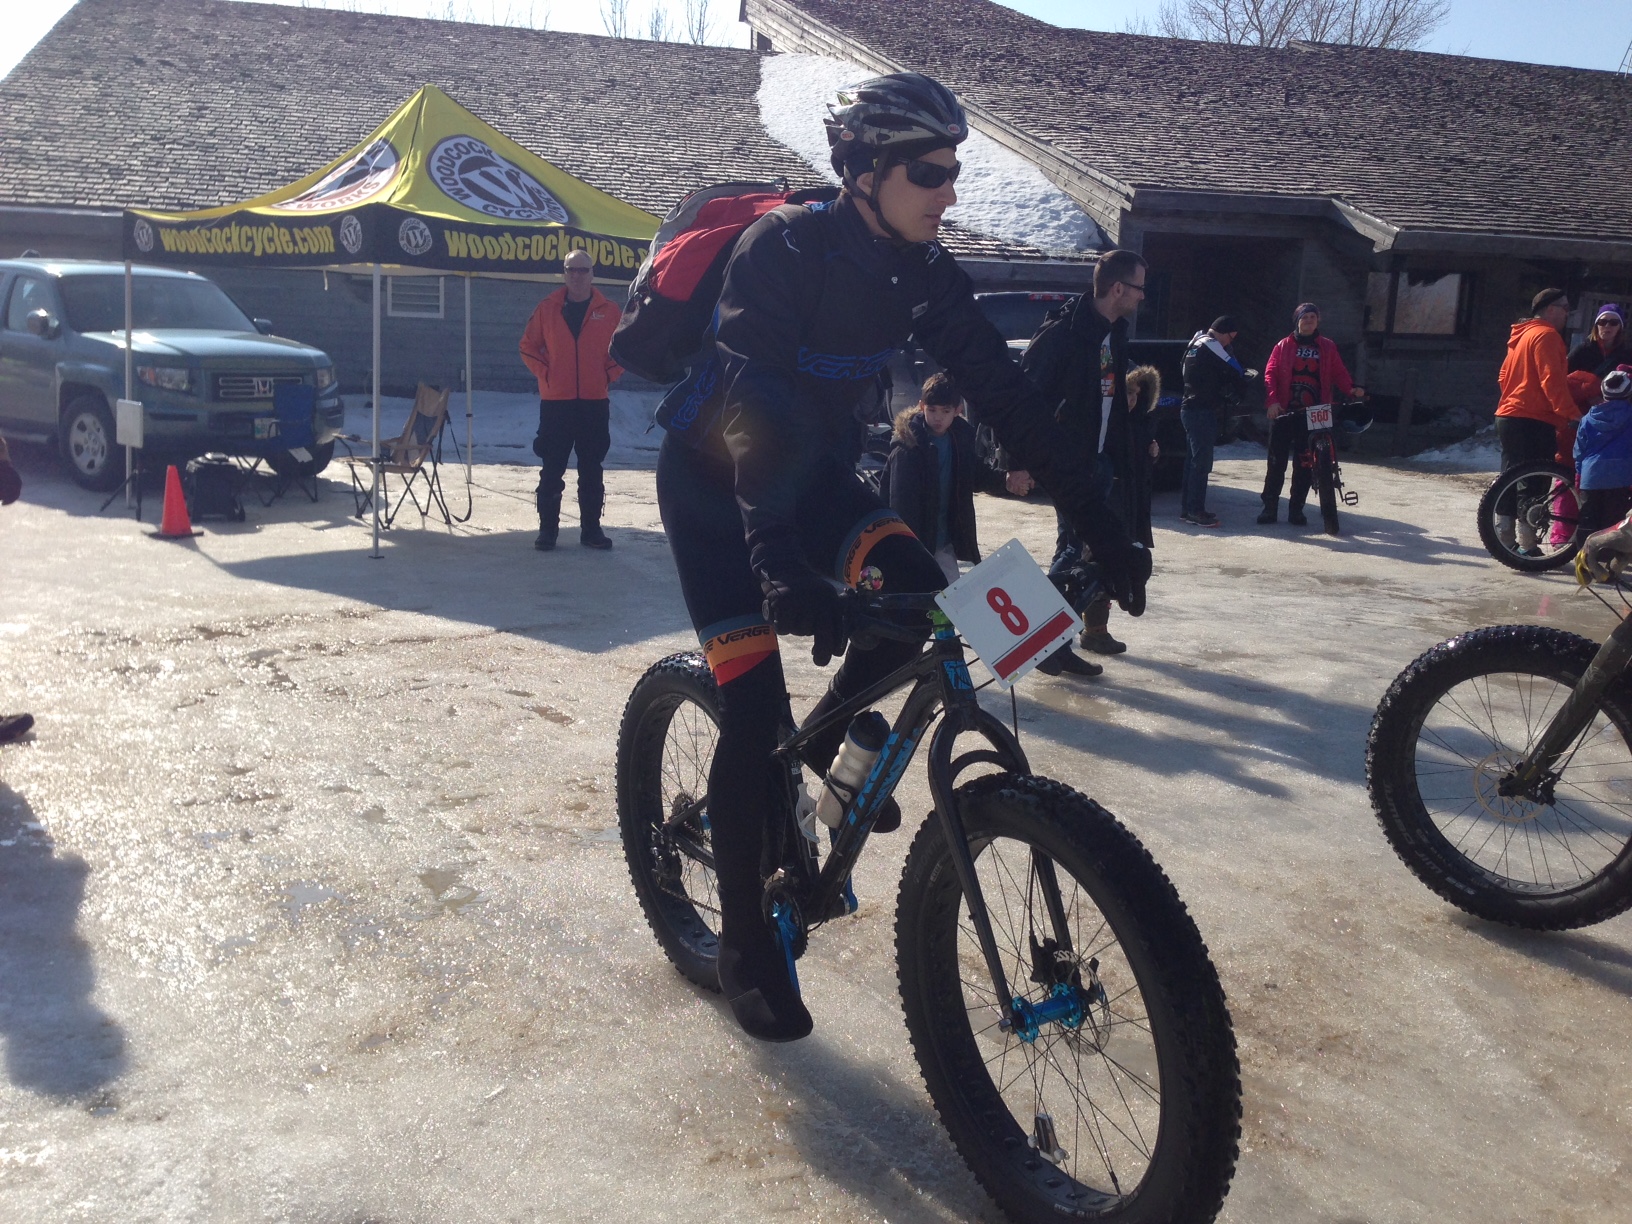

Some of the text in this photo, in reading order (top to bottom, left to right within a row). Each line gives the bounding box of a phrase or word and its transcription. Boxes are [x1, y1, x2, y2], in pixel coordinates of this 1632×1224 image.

[436, 141, 498, 200] WOODCOCK
[296, 181, 380, 209] WORKS
[160, 221, 335, 256] woodcockcycle.com
[1310, 410, 1329, 423] 560
[986, 587, 1029, 636] 8
[717, 625, 770, 645] VERGE
